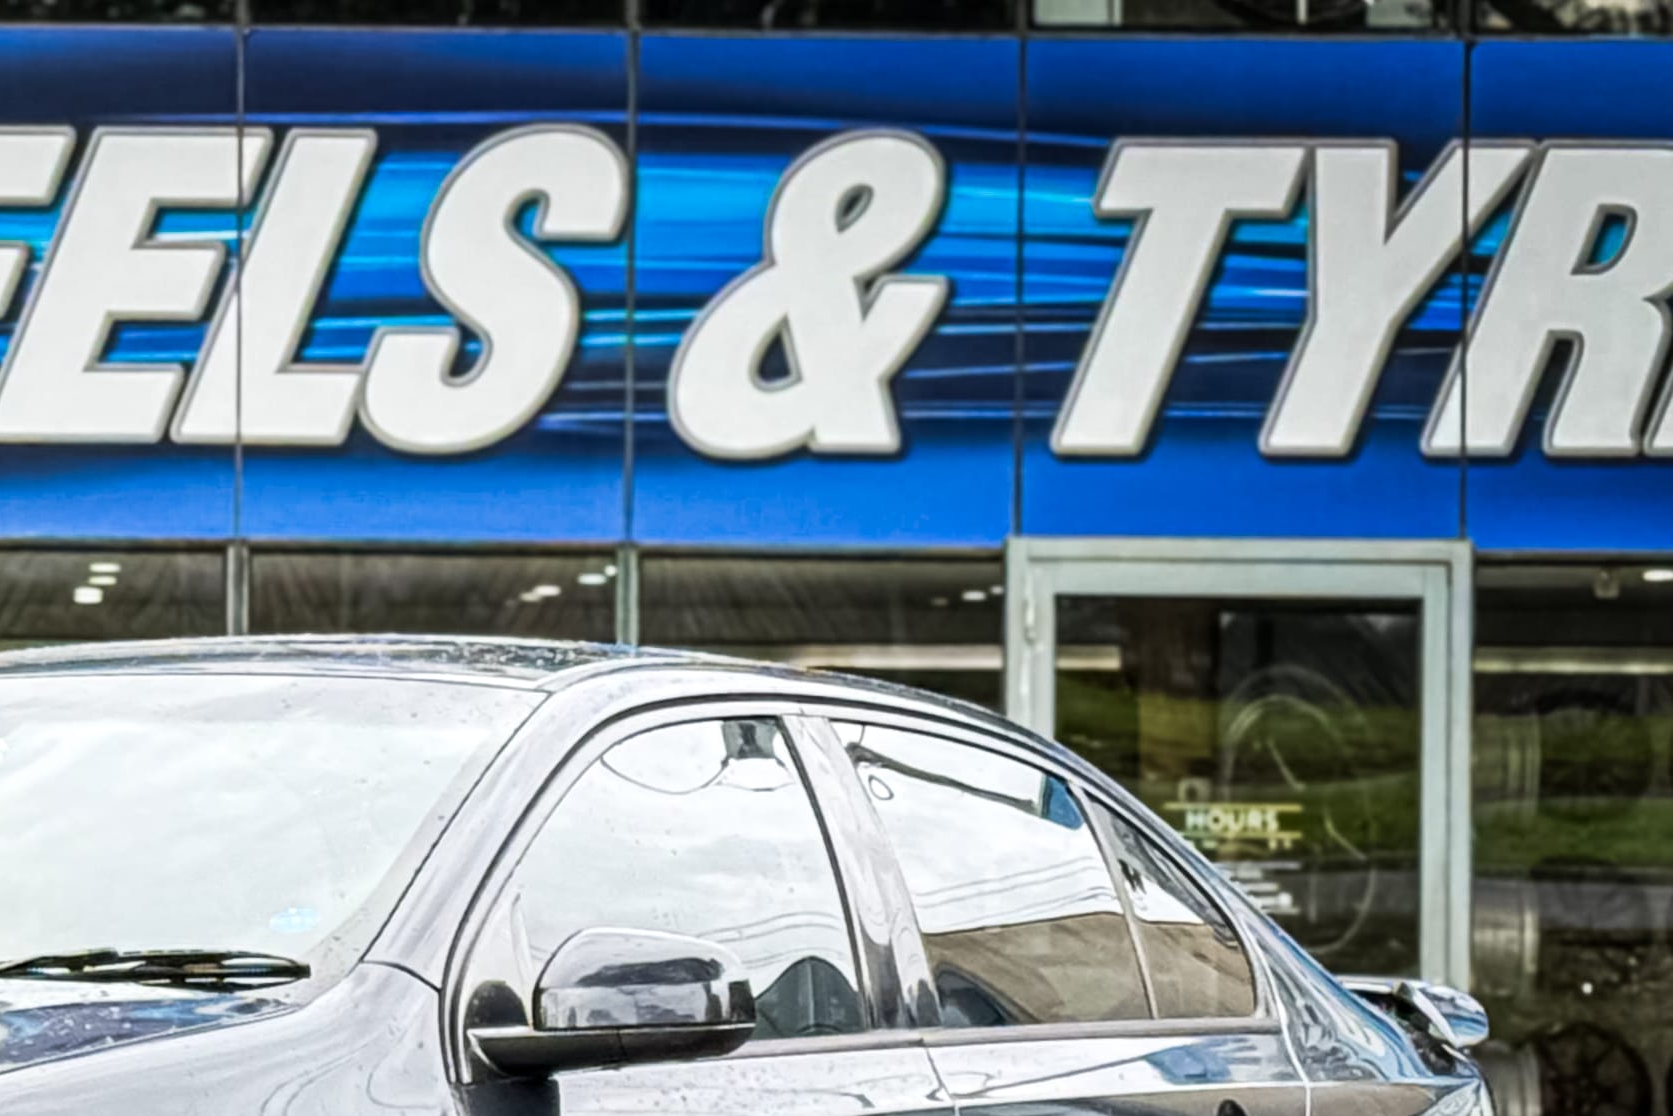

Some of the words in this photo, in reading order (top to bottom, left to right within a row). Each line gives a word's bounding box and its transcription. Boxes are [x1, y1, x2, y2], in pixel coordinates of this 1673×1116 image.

[668, 129, 950, 460] &
[1049, 137, 1673, 458] TYR
[1185, 809, 1280, 831] HOURS
